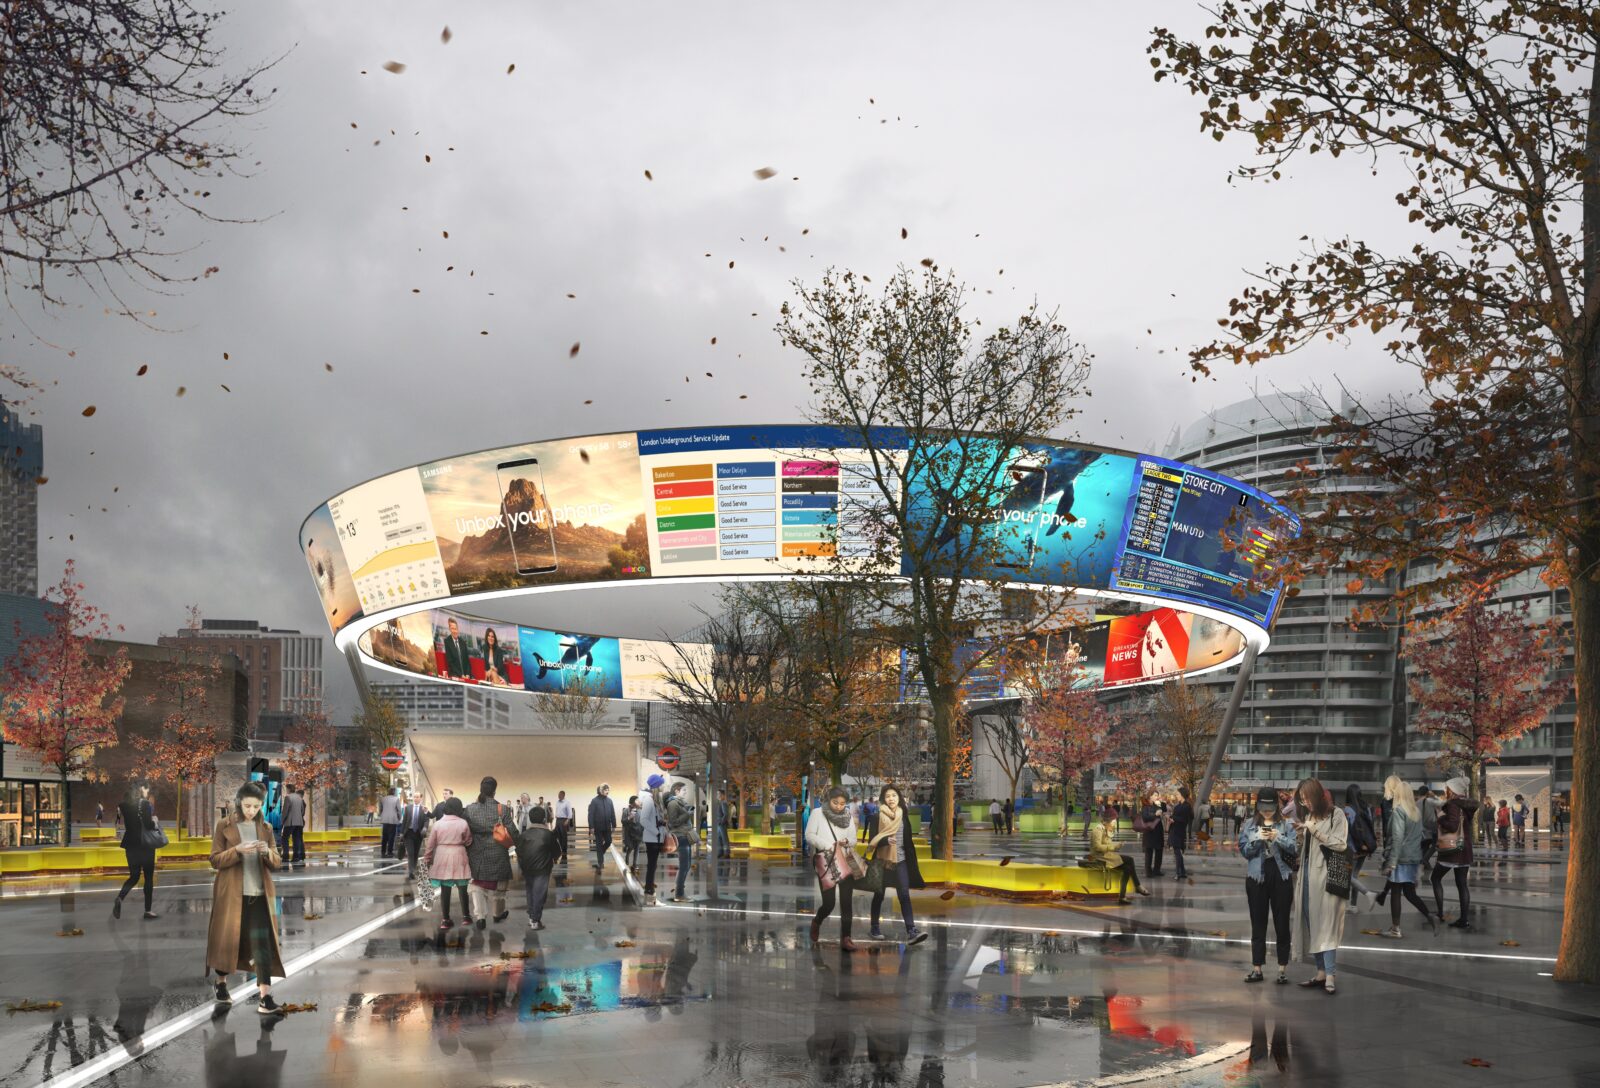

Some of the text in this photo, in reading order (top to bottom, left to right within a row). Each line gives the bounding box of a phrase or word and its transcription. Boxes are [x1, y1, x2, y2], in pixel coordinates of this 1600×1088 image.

[640, 433, 730, 447] London Underground Service Update
[731, 467, 747, 475] Delays
[1184, 474, 1210, 491] STOKE
[1209, 482, 1228, 496] CITY
[733, 499, 748, 507] Service
[783, 499, 804, 507] Piccadilly
[455, 501, 613, 534] Unbox your phone
[1002, 509, 1039, 523] your
[346, 522, 357, 538] 13
[1171, 521, 1205, 539] MAN UTD
[1150, 560, 1172, 570] COVENTRY
[1111, 650, 1138, 662] NEWS
[538, 659, 603, 673] Unbox your phone
